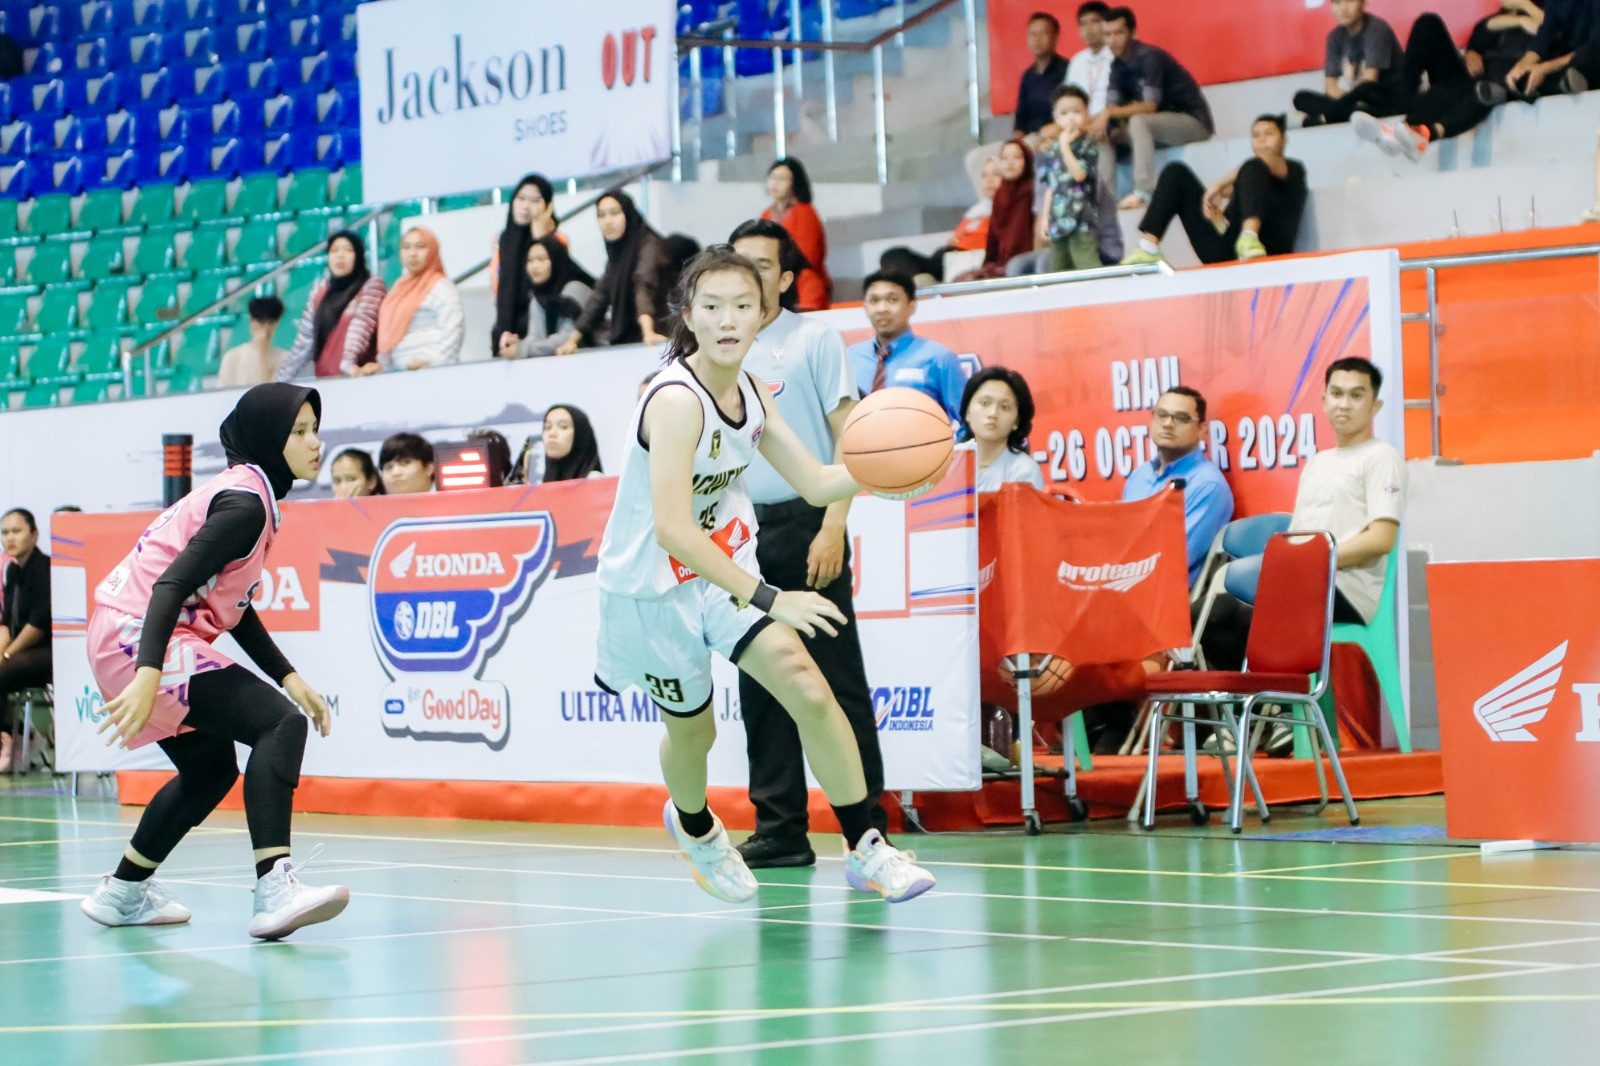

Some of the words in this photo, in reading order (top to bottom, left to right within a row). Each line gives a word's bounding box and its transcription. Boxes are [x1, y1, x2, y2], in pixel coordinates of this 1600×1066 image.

[601, 26, 656, 90] OUT
[377, 34, 567, 124] Jackson
[514, 110, 568, 141] SHOES
[1095, 418, 1230, 480] OCTR
[1238, 412, 1317, 470] 2024
[415, 551, 506, 577] HONDA
[414, 600, 459, 639] DBL
[645, 673, 684, 703] 33
[560, 690, 626, 723] ULTRA
[889, 720, 934, 731] INDONESIA
